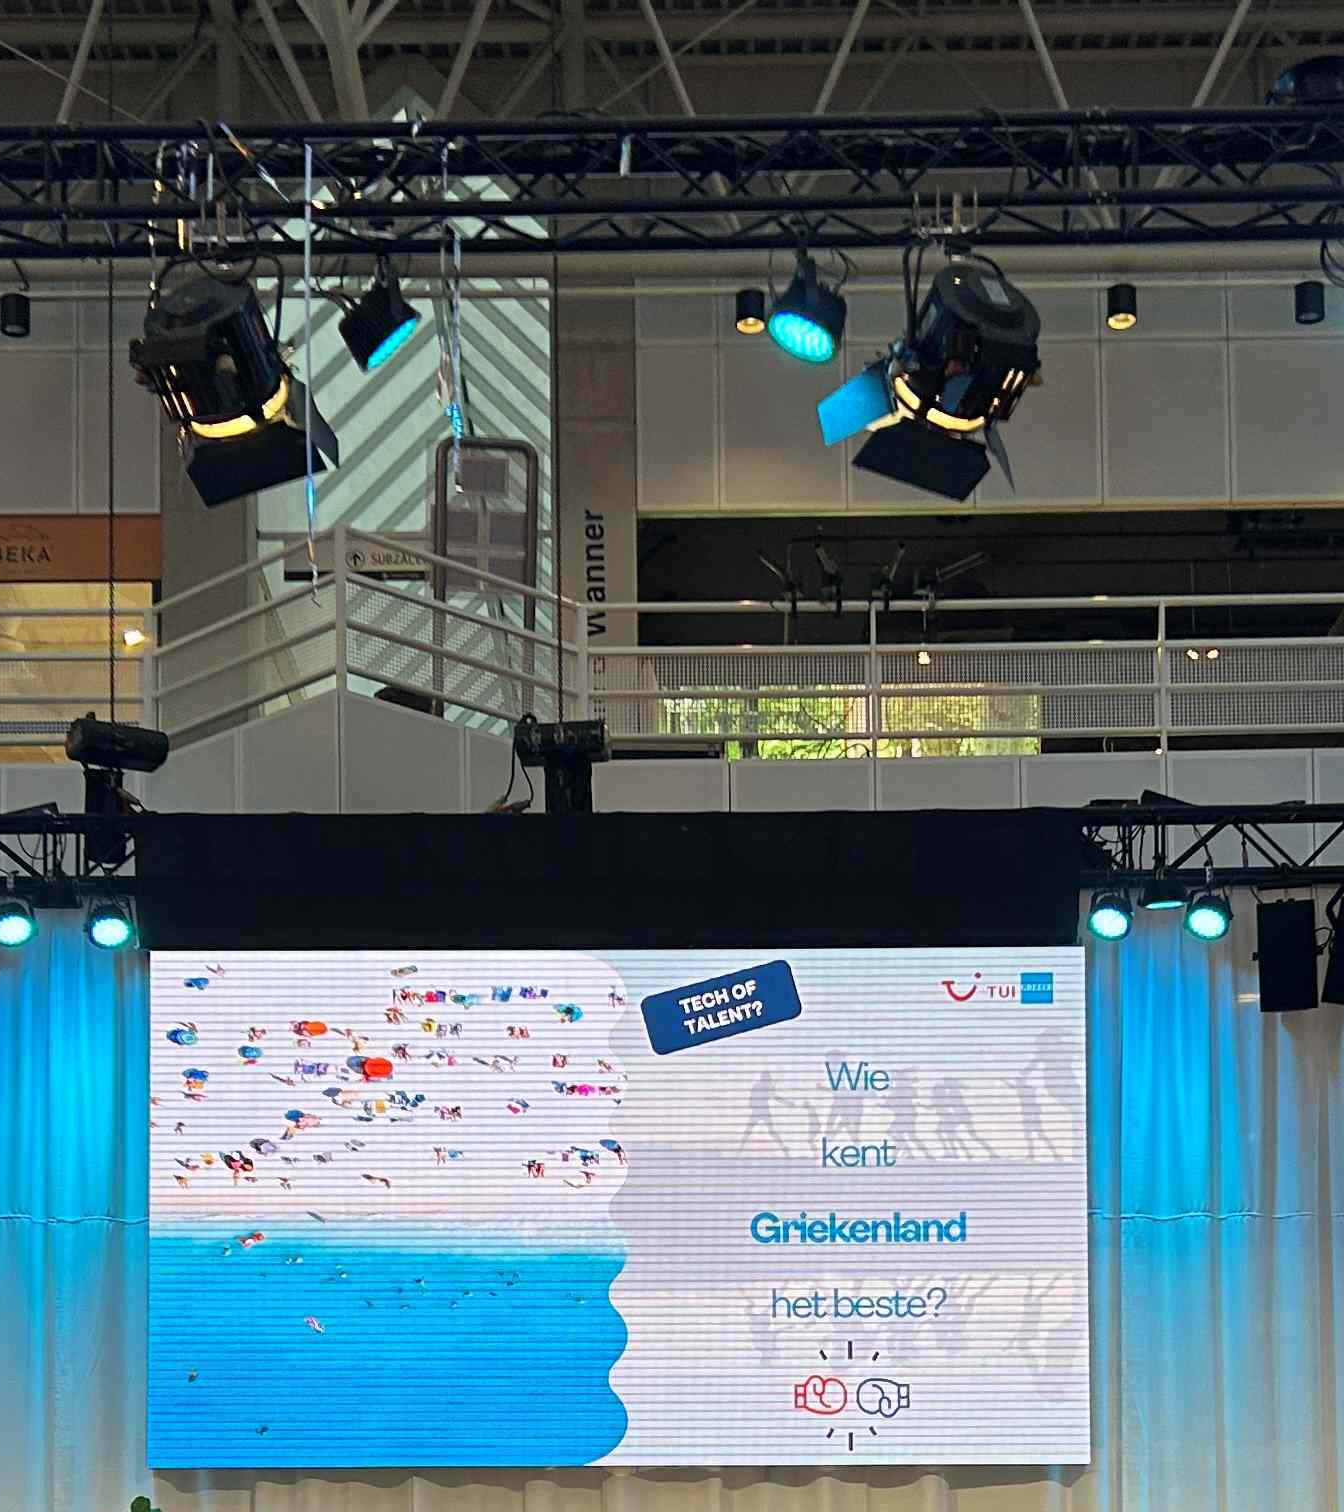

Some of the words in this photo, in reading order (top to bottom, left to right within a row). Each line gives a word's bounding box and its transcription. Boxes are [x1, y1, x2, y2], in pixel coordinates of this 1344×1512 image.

[585, 509, 606, 637] Wanner
[679, 988, 729, 1014] TECH
[732, 980, 756, 1000] OF
[988, 986, 1017, 998] TUI
[684, 1001, 762, 1034] TALENT?
[825, 1061, 890, 1092] Wie
[822, 1138, 897, 1168] kent
[750, 1211, 966, 1244] Griekenland
[771, 1288, 825, 1319] het
[833, 1287, 947, 1319] beste?
